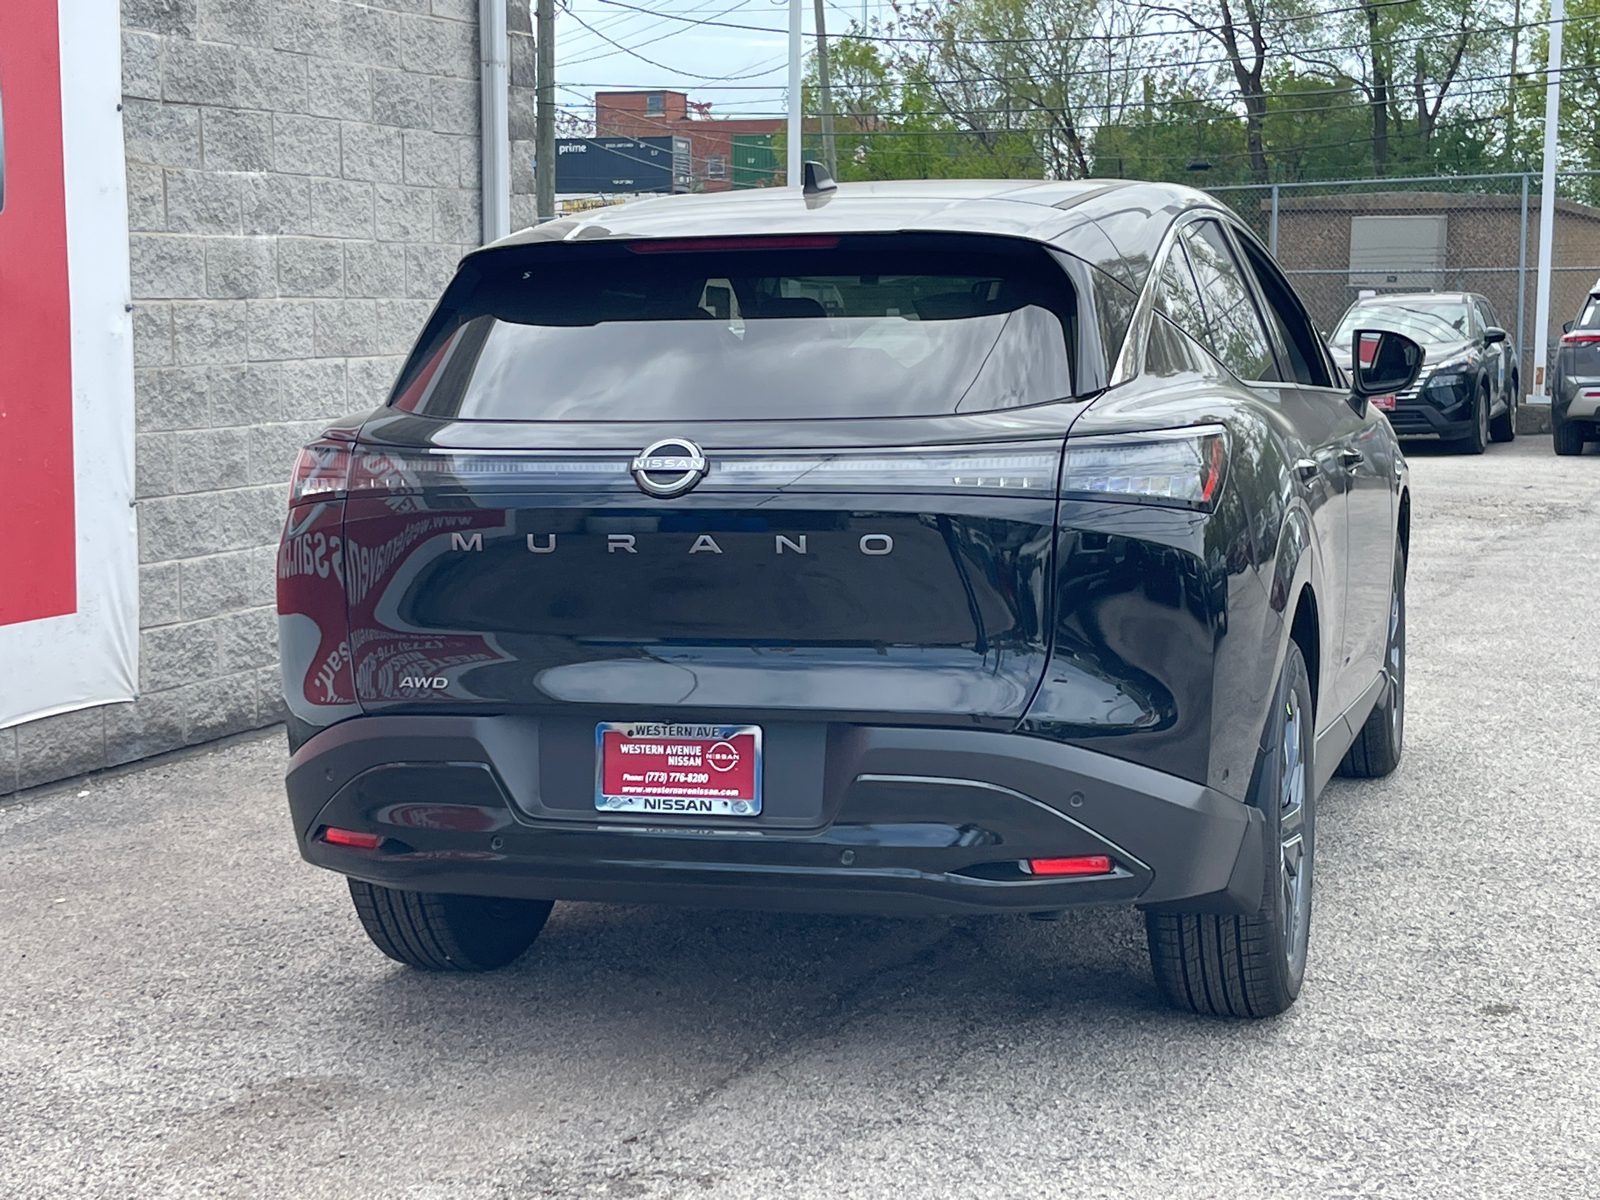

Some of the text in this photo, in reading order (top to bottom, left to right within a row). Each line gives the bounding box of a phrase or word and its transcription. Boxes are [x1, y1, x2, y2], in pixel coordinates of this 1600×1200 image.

[559, 143, 587, 155] prime
[632, 456, 705, 470] NISSAN
[450, 532, 895, 557] MURANO
[399, 676, 449, 690] AWD
[635, 724, 720, 739] WESTERN AVE
[620, 743, 702, 756] WESTERN AVENUE
[668, 756, 702, 767] NISSAN
[706, 753, 740, 761] NISSAN
[622, 772, 709, 784] Phone: (773) 776-8200
[622, 786, 739, 797] www.westernavenissan.com
[644, 798, 712, 812] NISSAN
